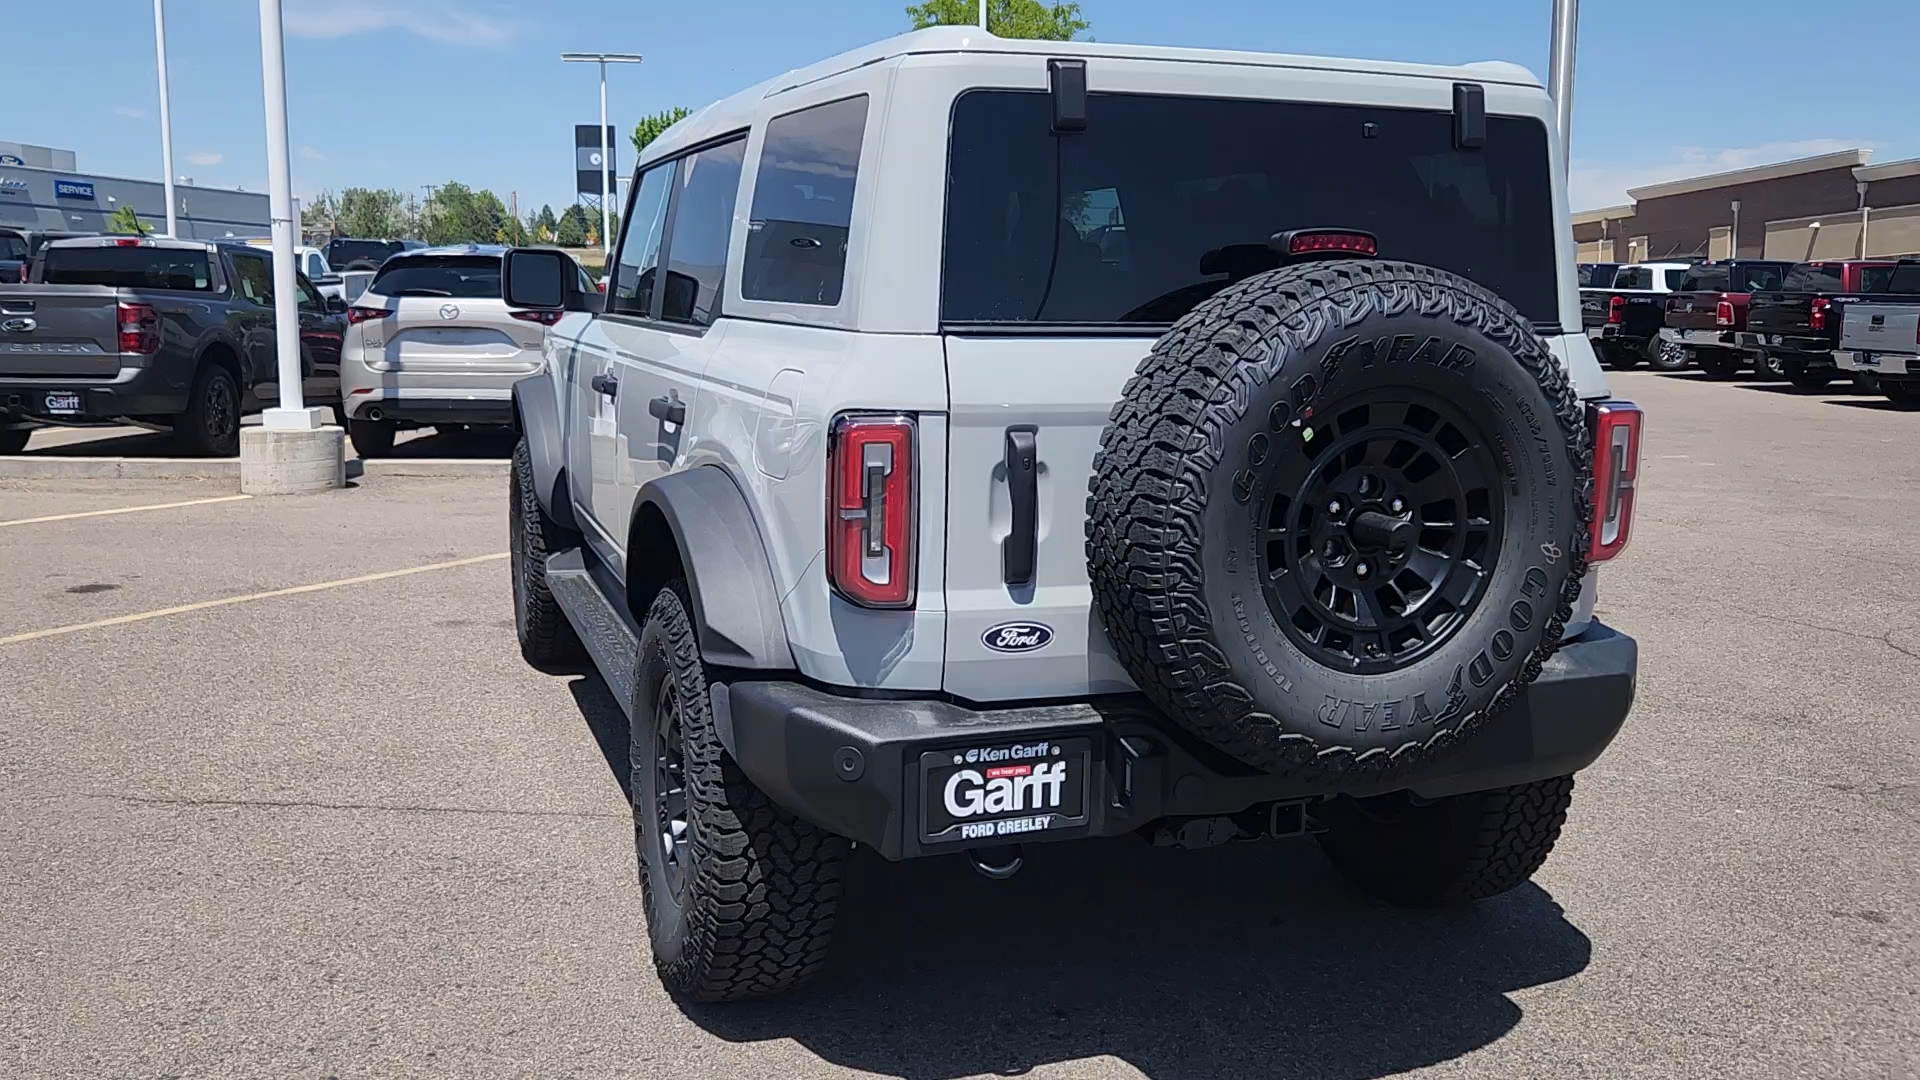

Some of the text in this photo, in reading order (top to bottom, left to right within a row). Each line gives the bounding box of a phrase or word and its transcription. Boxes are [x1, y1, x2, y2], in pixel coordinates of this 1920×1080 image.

[58, 184, 93, 196] SERVICE
[45, 396, 79, 408] Garff
[996, 627, 1041, 647] Ford
[1231, 592, 1294, 694] TERRITORY
[979, 741, 1049, 762] Ken Garff
[944, 761, 1066, 818] Garff
[961, 815, 1051, 839] FORD GREELEY
